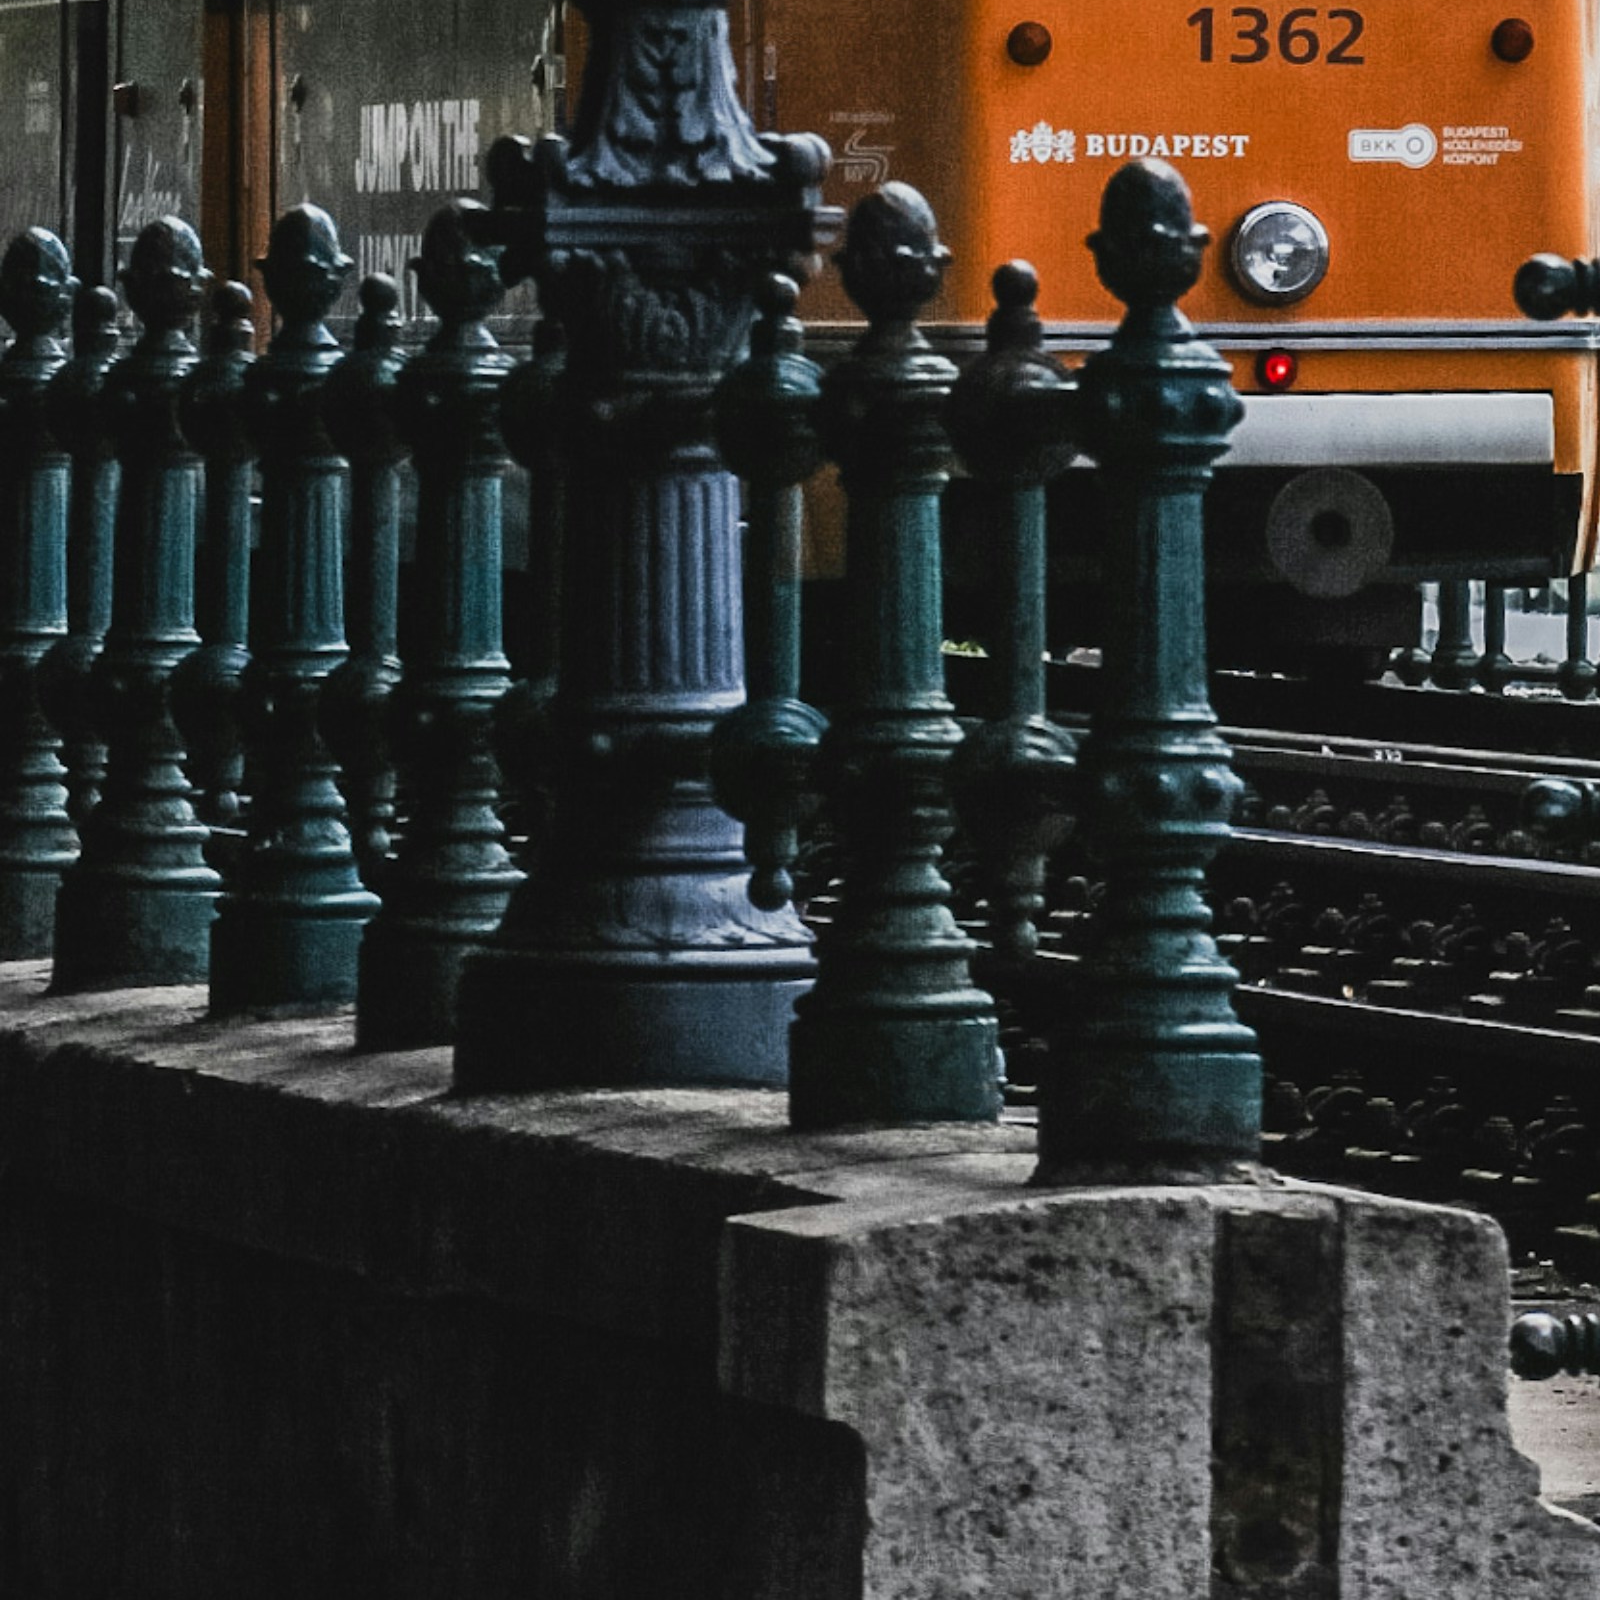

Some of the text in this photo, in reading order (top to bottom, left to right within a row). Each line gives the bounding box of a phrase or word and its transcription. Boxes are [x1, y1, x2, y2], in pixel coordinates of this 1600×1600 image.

[1186, 6, 1366, 66] 1362
[355, 99, 481, 193] JUMP ON THE
[1085, 134, 1249, 158] BUDAPEST
[1360, 138, 1398, 153] BKK
